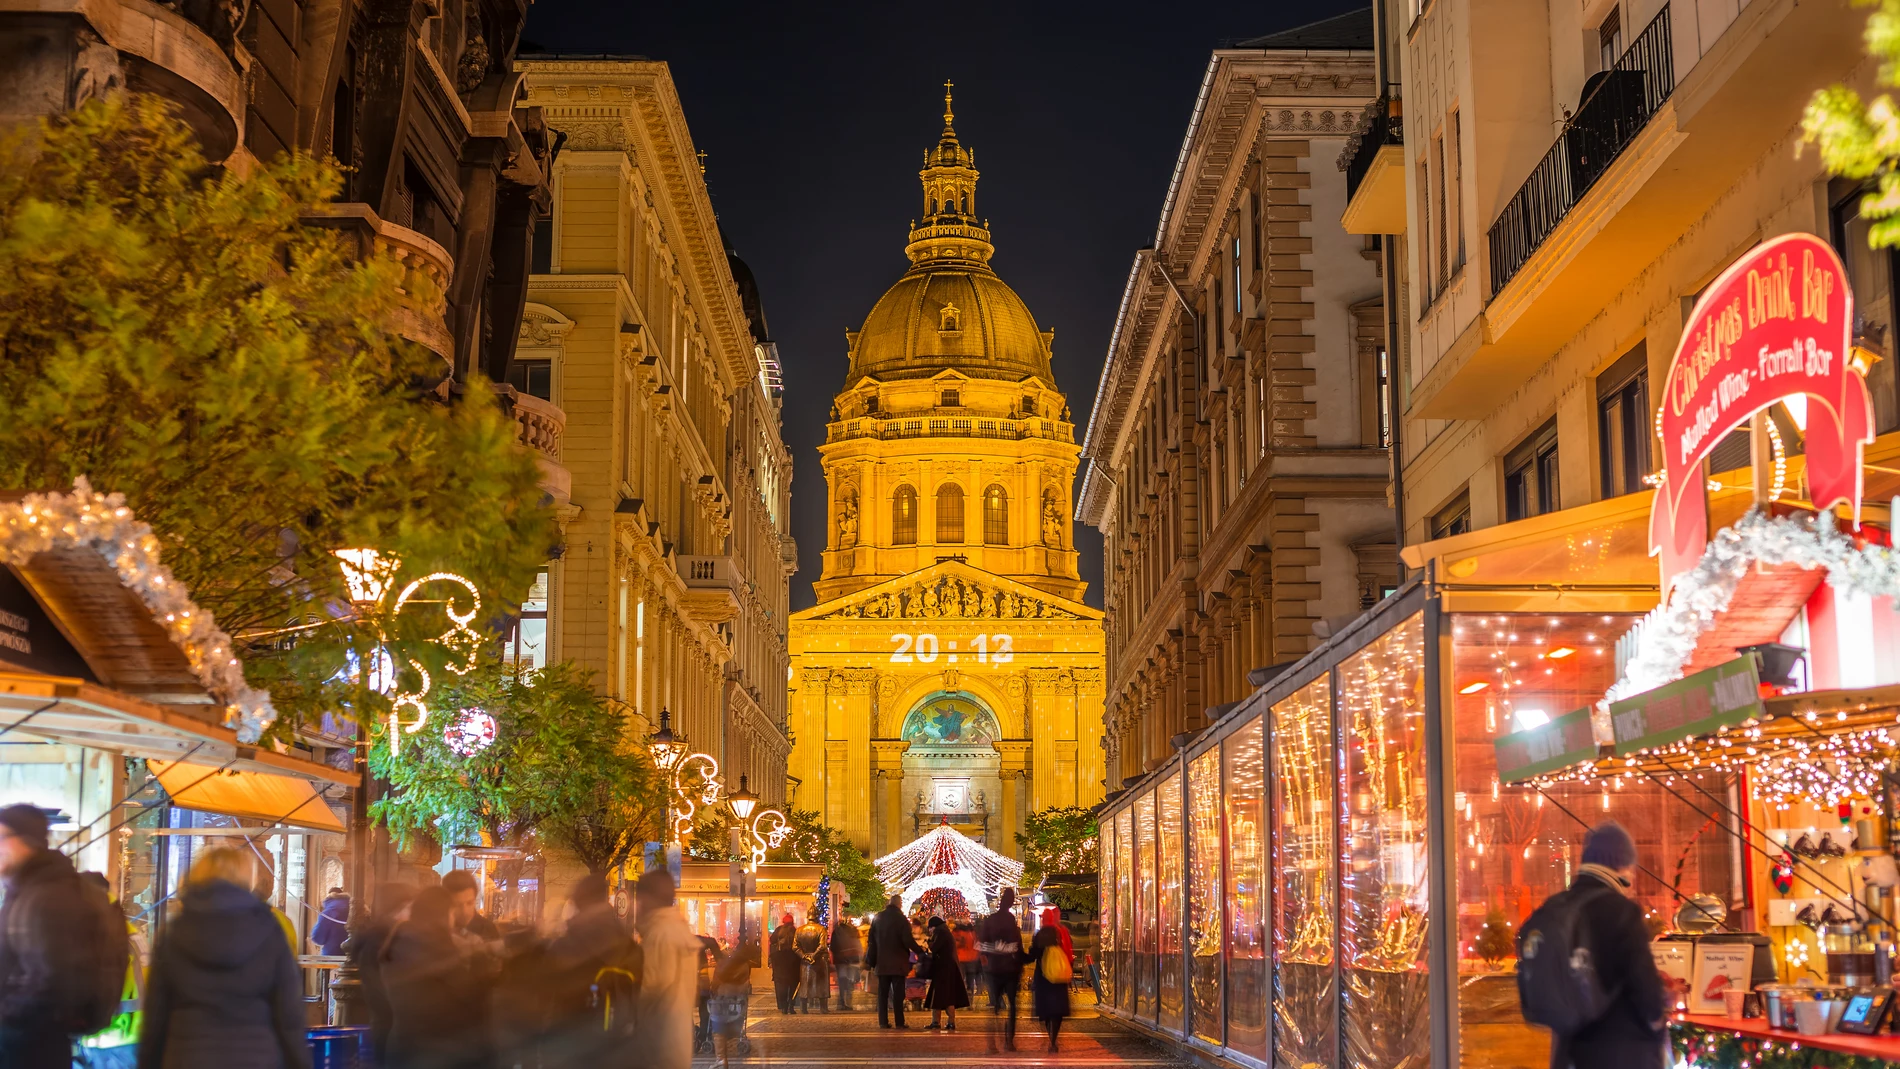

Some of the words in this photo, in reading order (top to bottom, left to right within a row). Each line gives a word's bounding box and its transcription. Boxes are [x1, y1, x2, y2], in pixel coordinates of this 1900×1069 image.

[1671, 297, 1743, 417] Christmas
[1747, 252, 1796, 330] Drink
[1802, 249, 1834, 324] Bar
[1680, 389, 1719, 465] Mulled
[1718, 369, 1750, 412] Wine
[1758, 338, 1804, 381] Forralt
[1805, 337, 1833, 377] Bor
